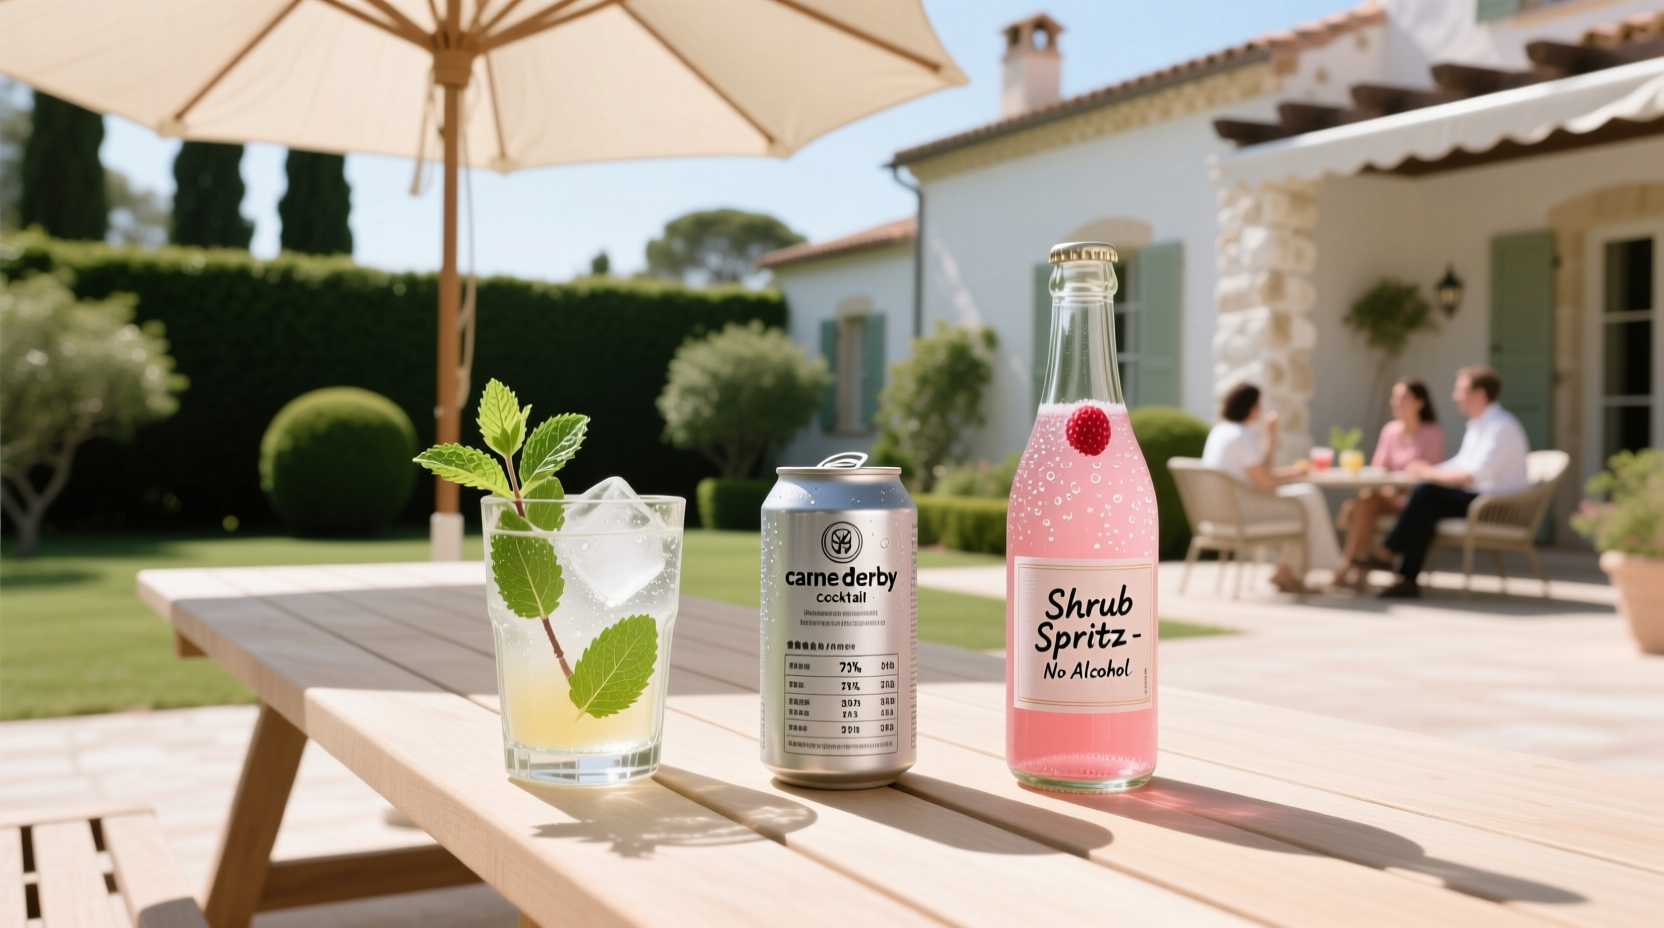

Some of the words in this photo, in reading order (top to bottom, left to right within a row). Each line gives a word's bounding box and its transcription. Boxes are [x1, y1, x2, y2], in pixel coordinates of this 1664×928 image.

[785, 571, 839, 587] carne
[842, 566, 898, 592] derby
[816, 591, 867, 603] cocktail
[1045, 584, 1133, 620] Shrub
[1043, 661, 1067, 680] No
[1070, 657, 1133, 680] Alcohol
